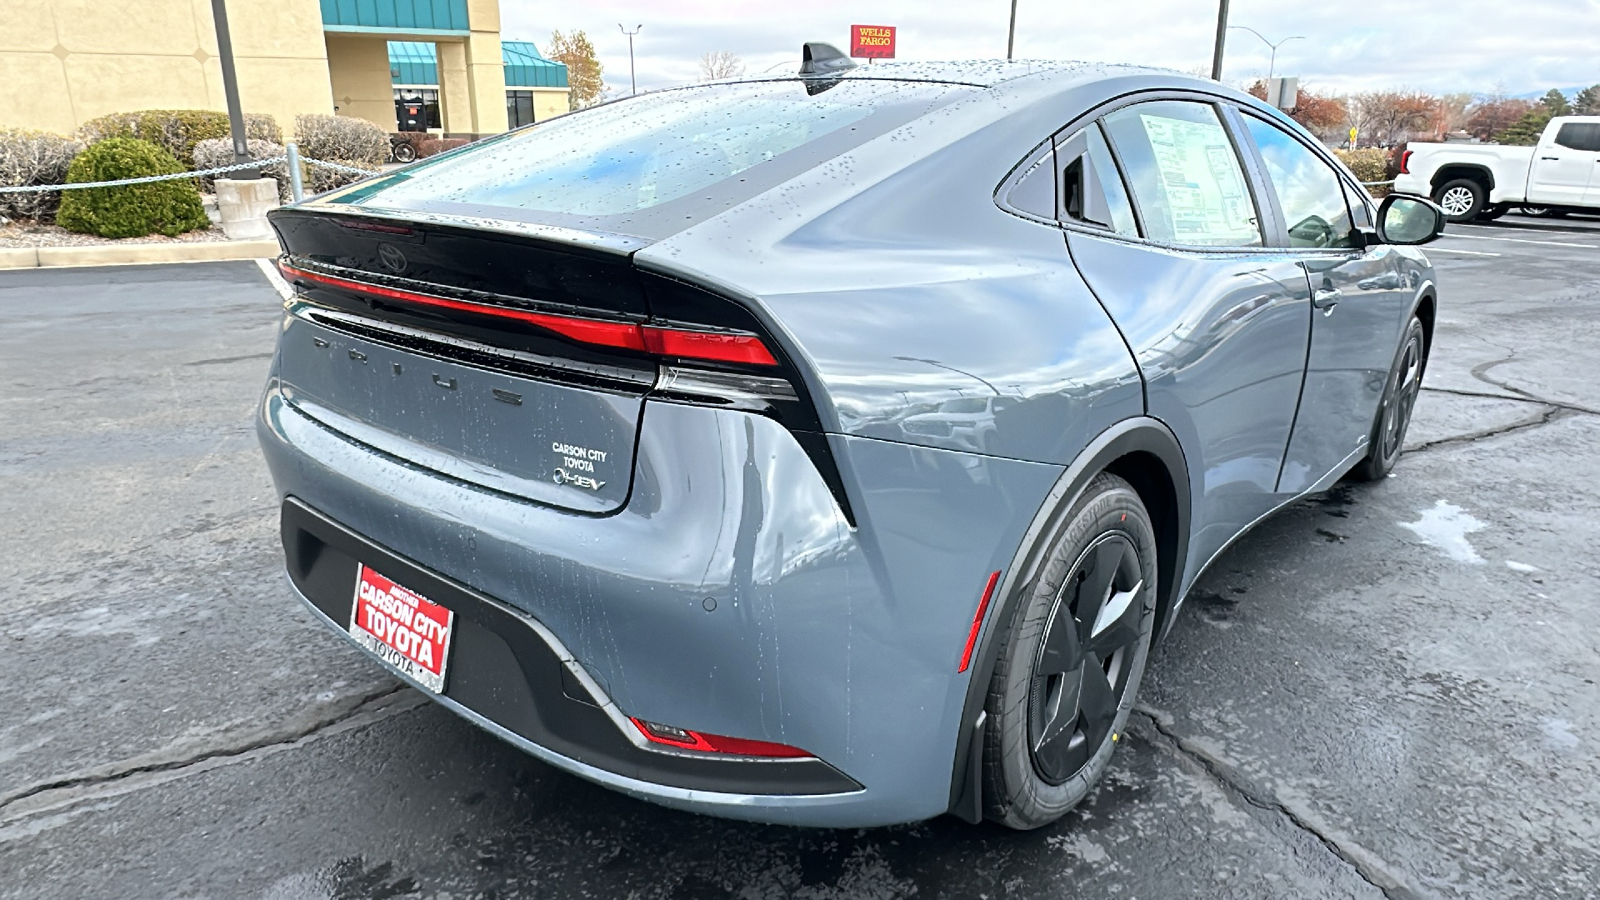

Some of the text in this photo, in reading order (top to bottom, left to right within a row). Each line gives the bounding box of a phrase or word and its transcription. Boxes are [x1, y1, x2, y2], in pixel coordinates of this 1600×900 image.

[860, 28, 891, 37] WELLS
[860, 37, 891, 46] FARGO
[313, 336, 523, 406] PRIUS
[552, 442, 607, 462] CARSON CITY
[563, 456, 595, 473] TOYOTA
[389, 585, 420, 609] ANOTHER
[359, 580, 448, 645] CARSON CITY
[365, 603, 434, 669] TOYOTA
[373, 637, 414, 675] TOYOTA
